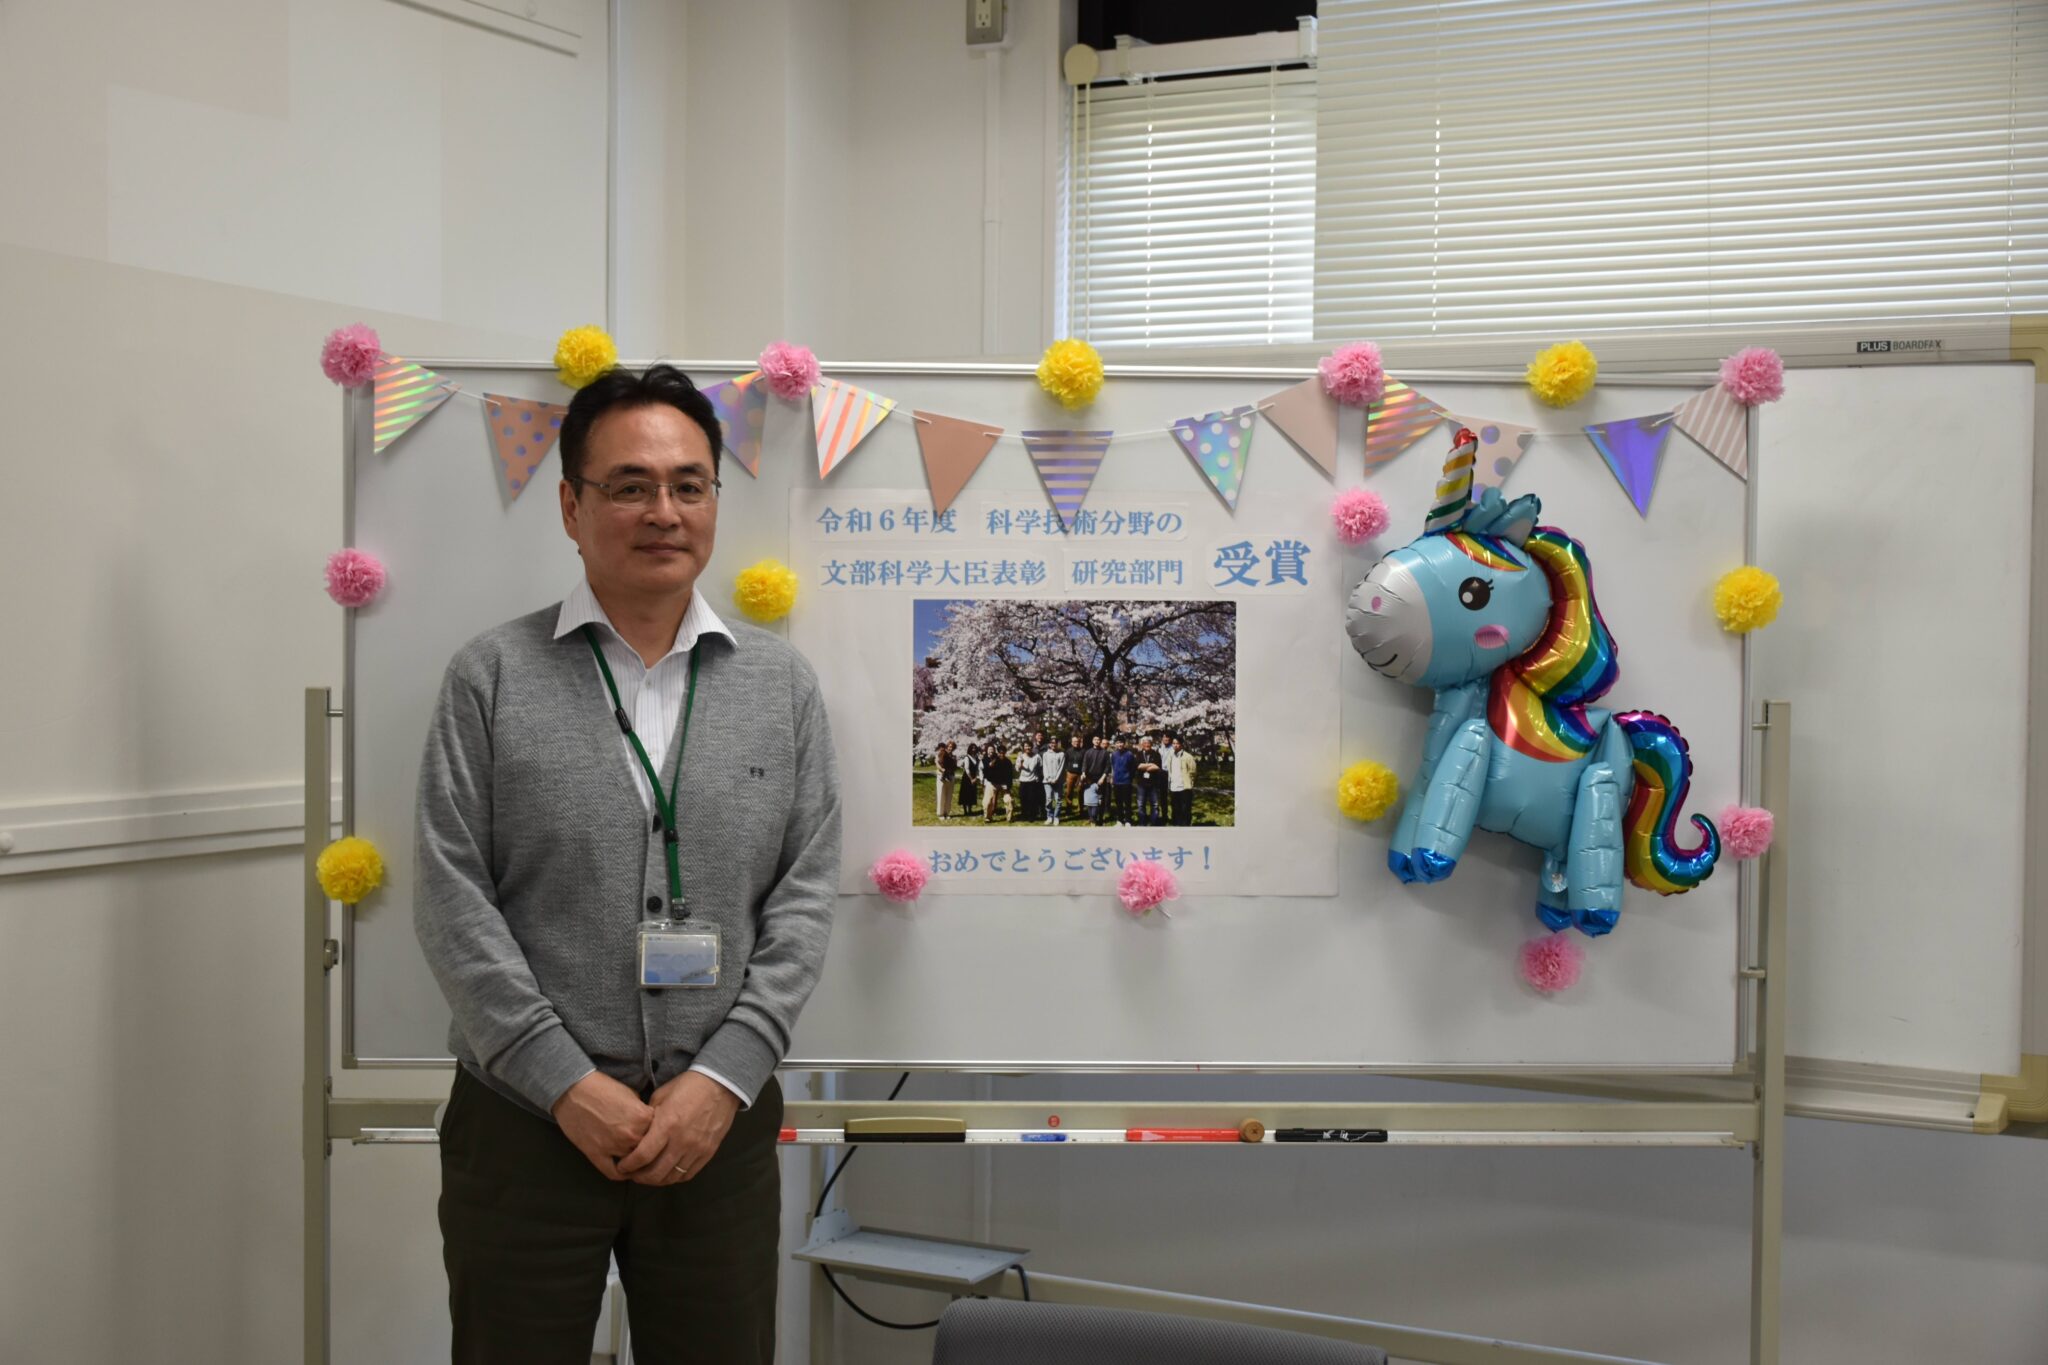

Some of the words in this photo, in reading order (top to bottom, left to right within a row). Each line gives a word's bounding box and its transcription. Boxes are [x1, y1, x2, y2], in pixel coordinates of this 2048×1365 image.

[1860, 341, 1889, 352] PLUS
[1893, 340, 1942, 351] BOARDFAX
[816, 506, 958, 534] 令和6年度
[820, 559, 1047, 587] 文部科学大臣表彰
[1071, 558, 1184, 586] 研究部門
[1213, 539, 1312, 588] 受賞
